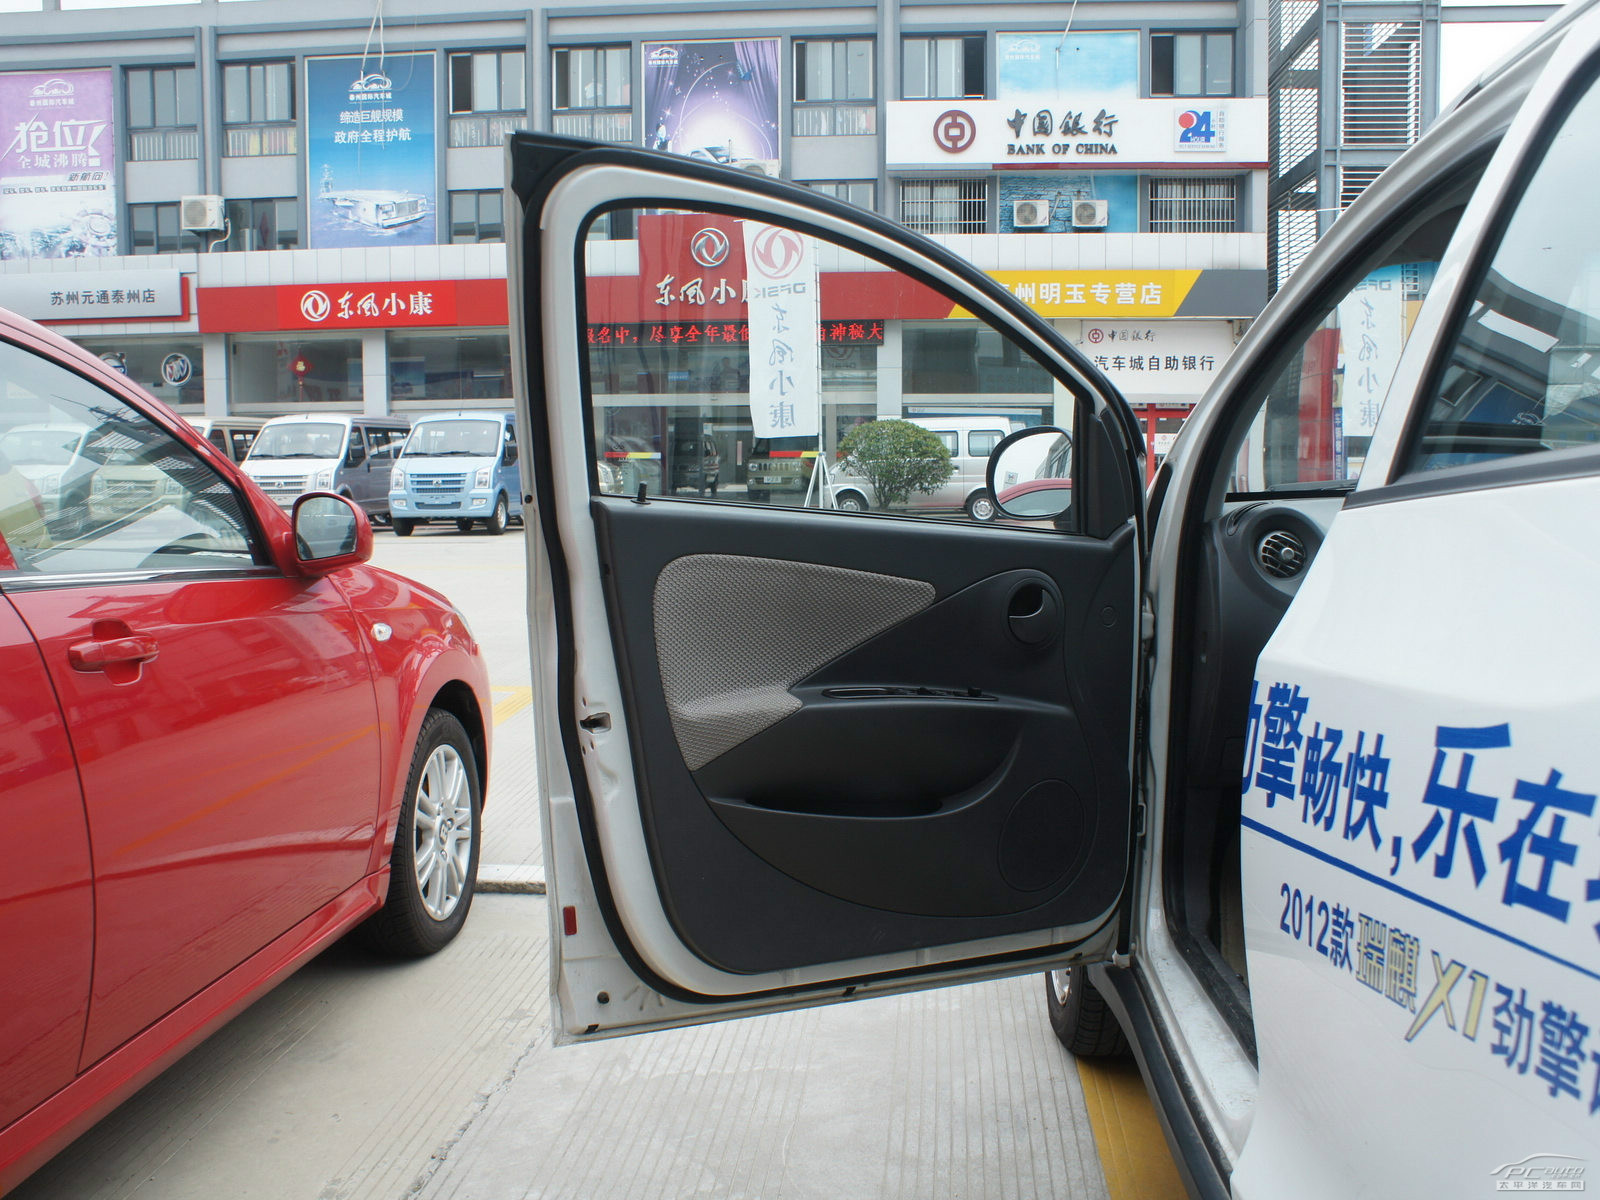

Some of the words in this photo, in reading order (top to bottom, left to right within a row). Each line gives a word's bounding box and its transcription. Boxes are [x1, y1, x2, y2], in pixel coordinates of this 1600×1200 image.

[339, 108, 404, 124] 缔造巨舰规模
[1006, 108, 1119, 138] 中国银行
[334, 128, 411, 144] 政府全程护航
[1007, 143, 1045, 155] BANK
[1052, 143, 1070, 155] OF
[1075, 143, 1118, 155] CHINA
[17, 152, 88, 169] 全城沸腾
[51, 287, 156, 306] 苏州元通泰州店
[655, 274, 750, 307] 东风小
[998, 282, 1163, 305] 州明玉专营店
[336, 290, 434, 318] 东风小康
[1107, 328, 1156, 343] 中国银行
[1094, 355, 1216, 372] 汽车城自助银行
